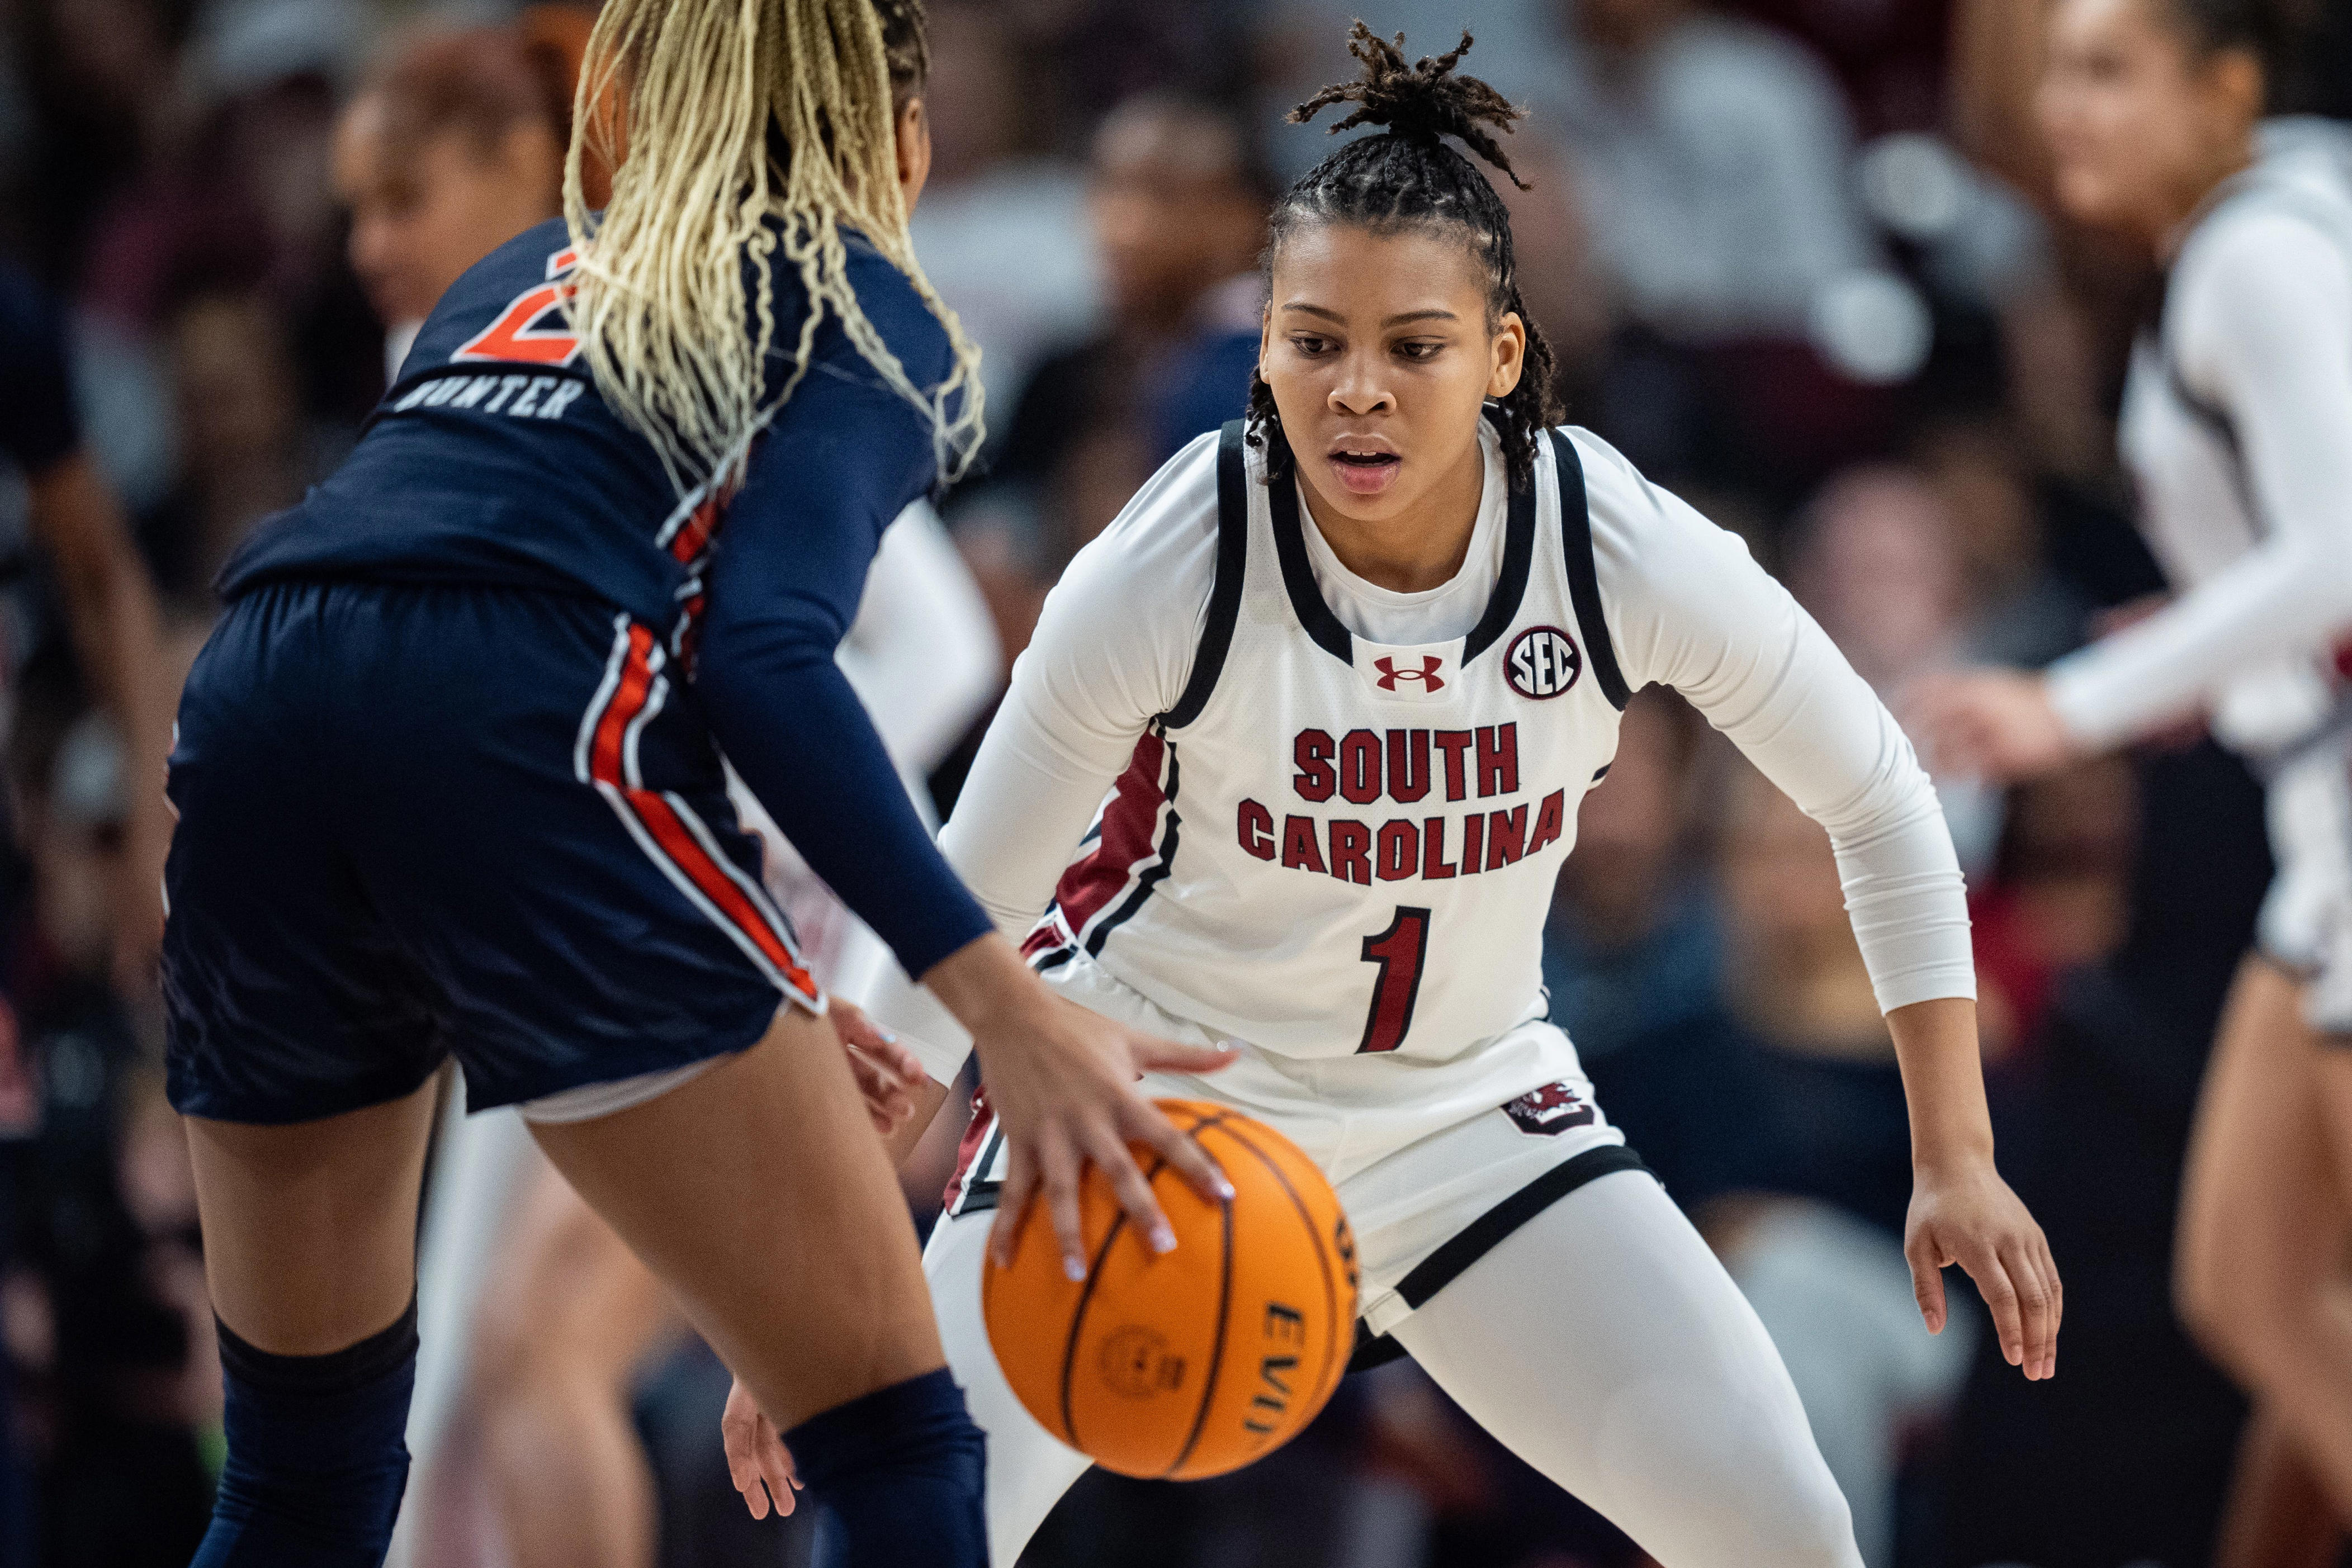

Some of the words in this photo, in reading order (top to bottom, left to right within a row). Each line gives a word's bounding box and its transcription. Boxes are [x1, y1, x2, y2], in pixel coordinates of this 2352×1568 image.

[1511, 632, 1574, 695] SEC
[1293, 722, 1520, 805] SOUTH
[1237, 788, 1565, 887] CAROLINA
[1354, 905, 1432, 1055] 1
